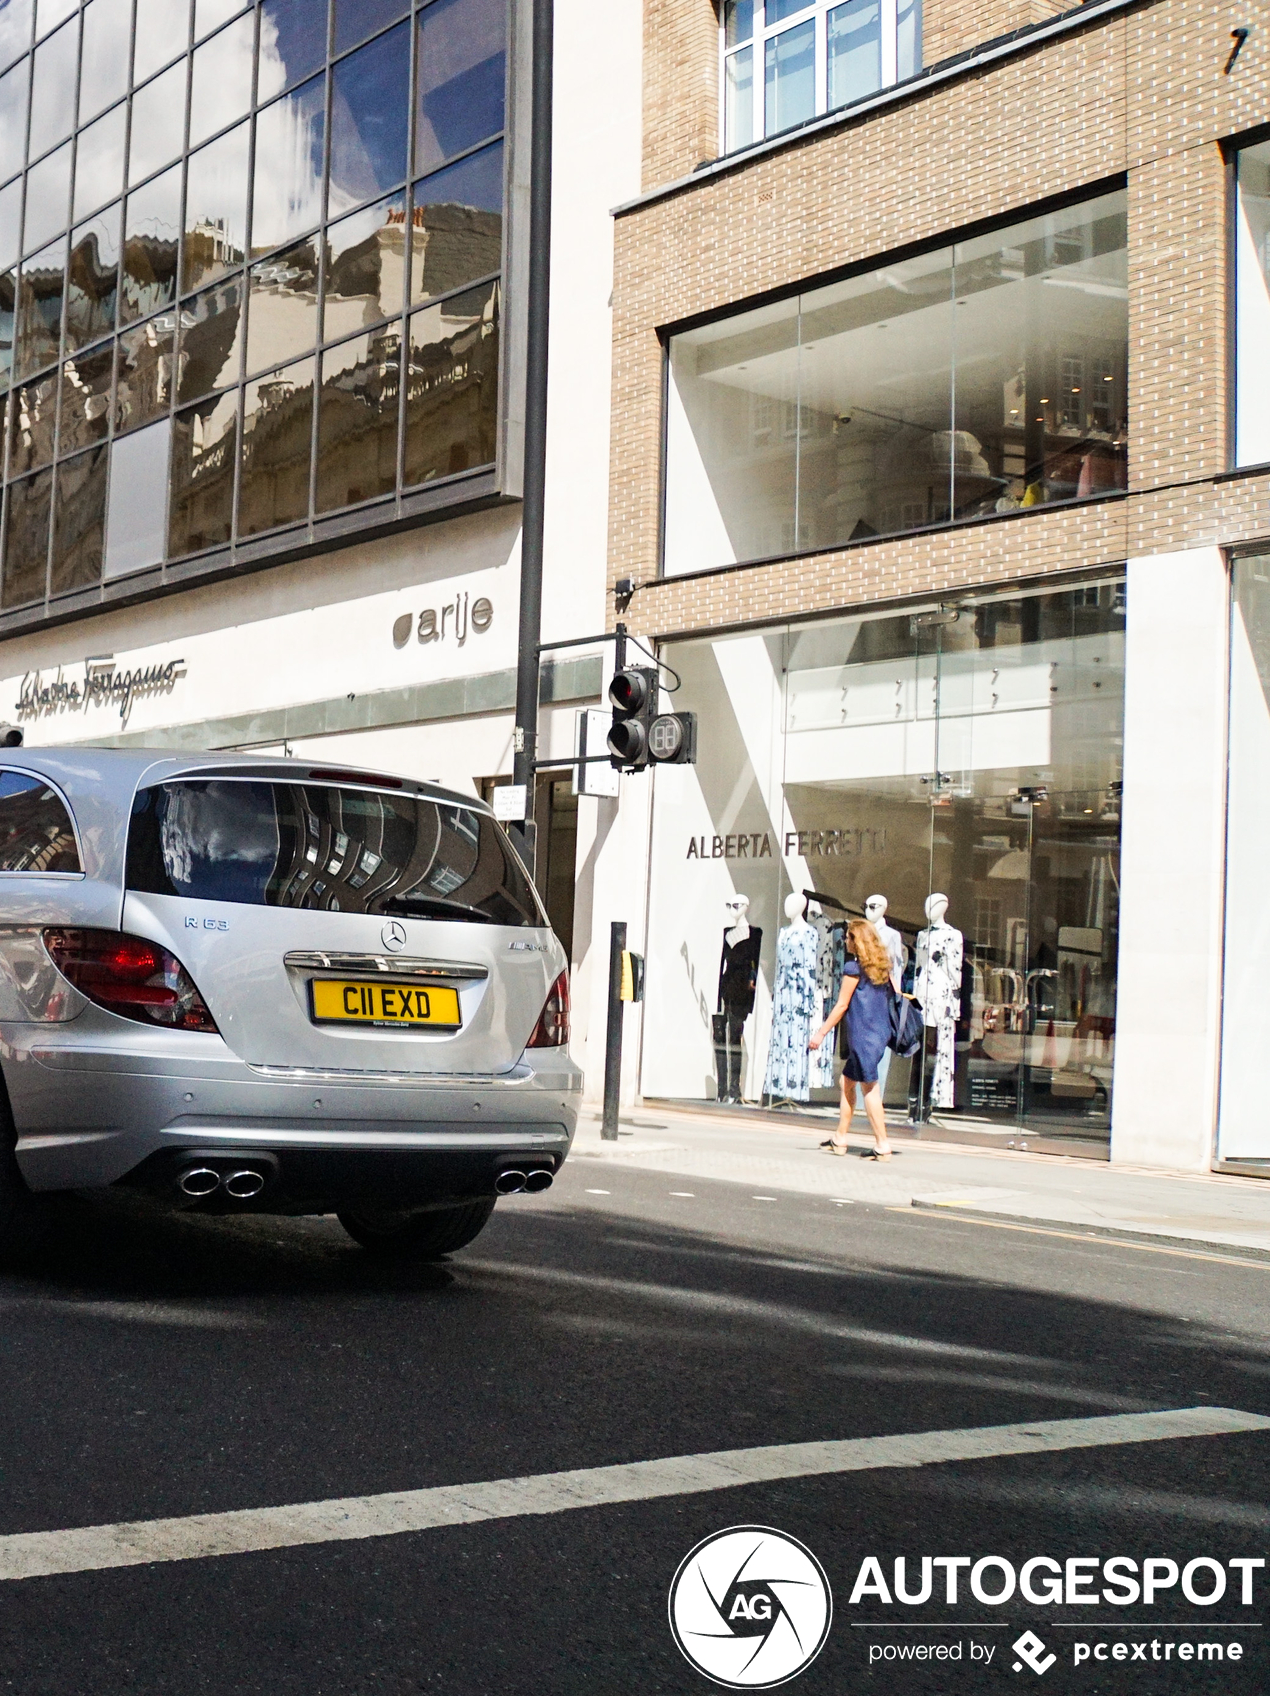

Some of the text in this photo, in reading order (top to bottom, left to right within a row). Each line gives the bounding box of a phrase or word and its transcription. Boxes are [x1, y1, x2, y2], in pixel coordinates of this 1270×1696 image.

[417, 591, 493, 642] arije
[686, 829, 887, 859] ALBERTA FERRETTI
[184, 916, 230, 931] R 63
[381, 988, 431, 1018] EXD
